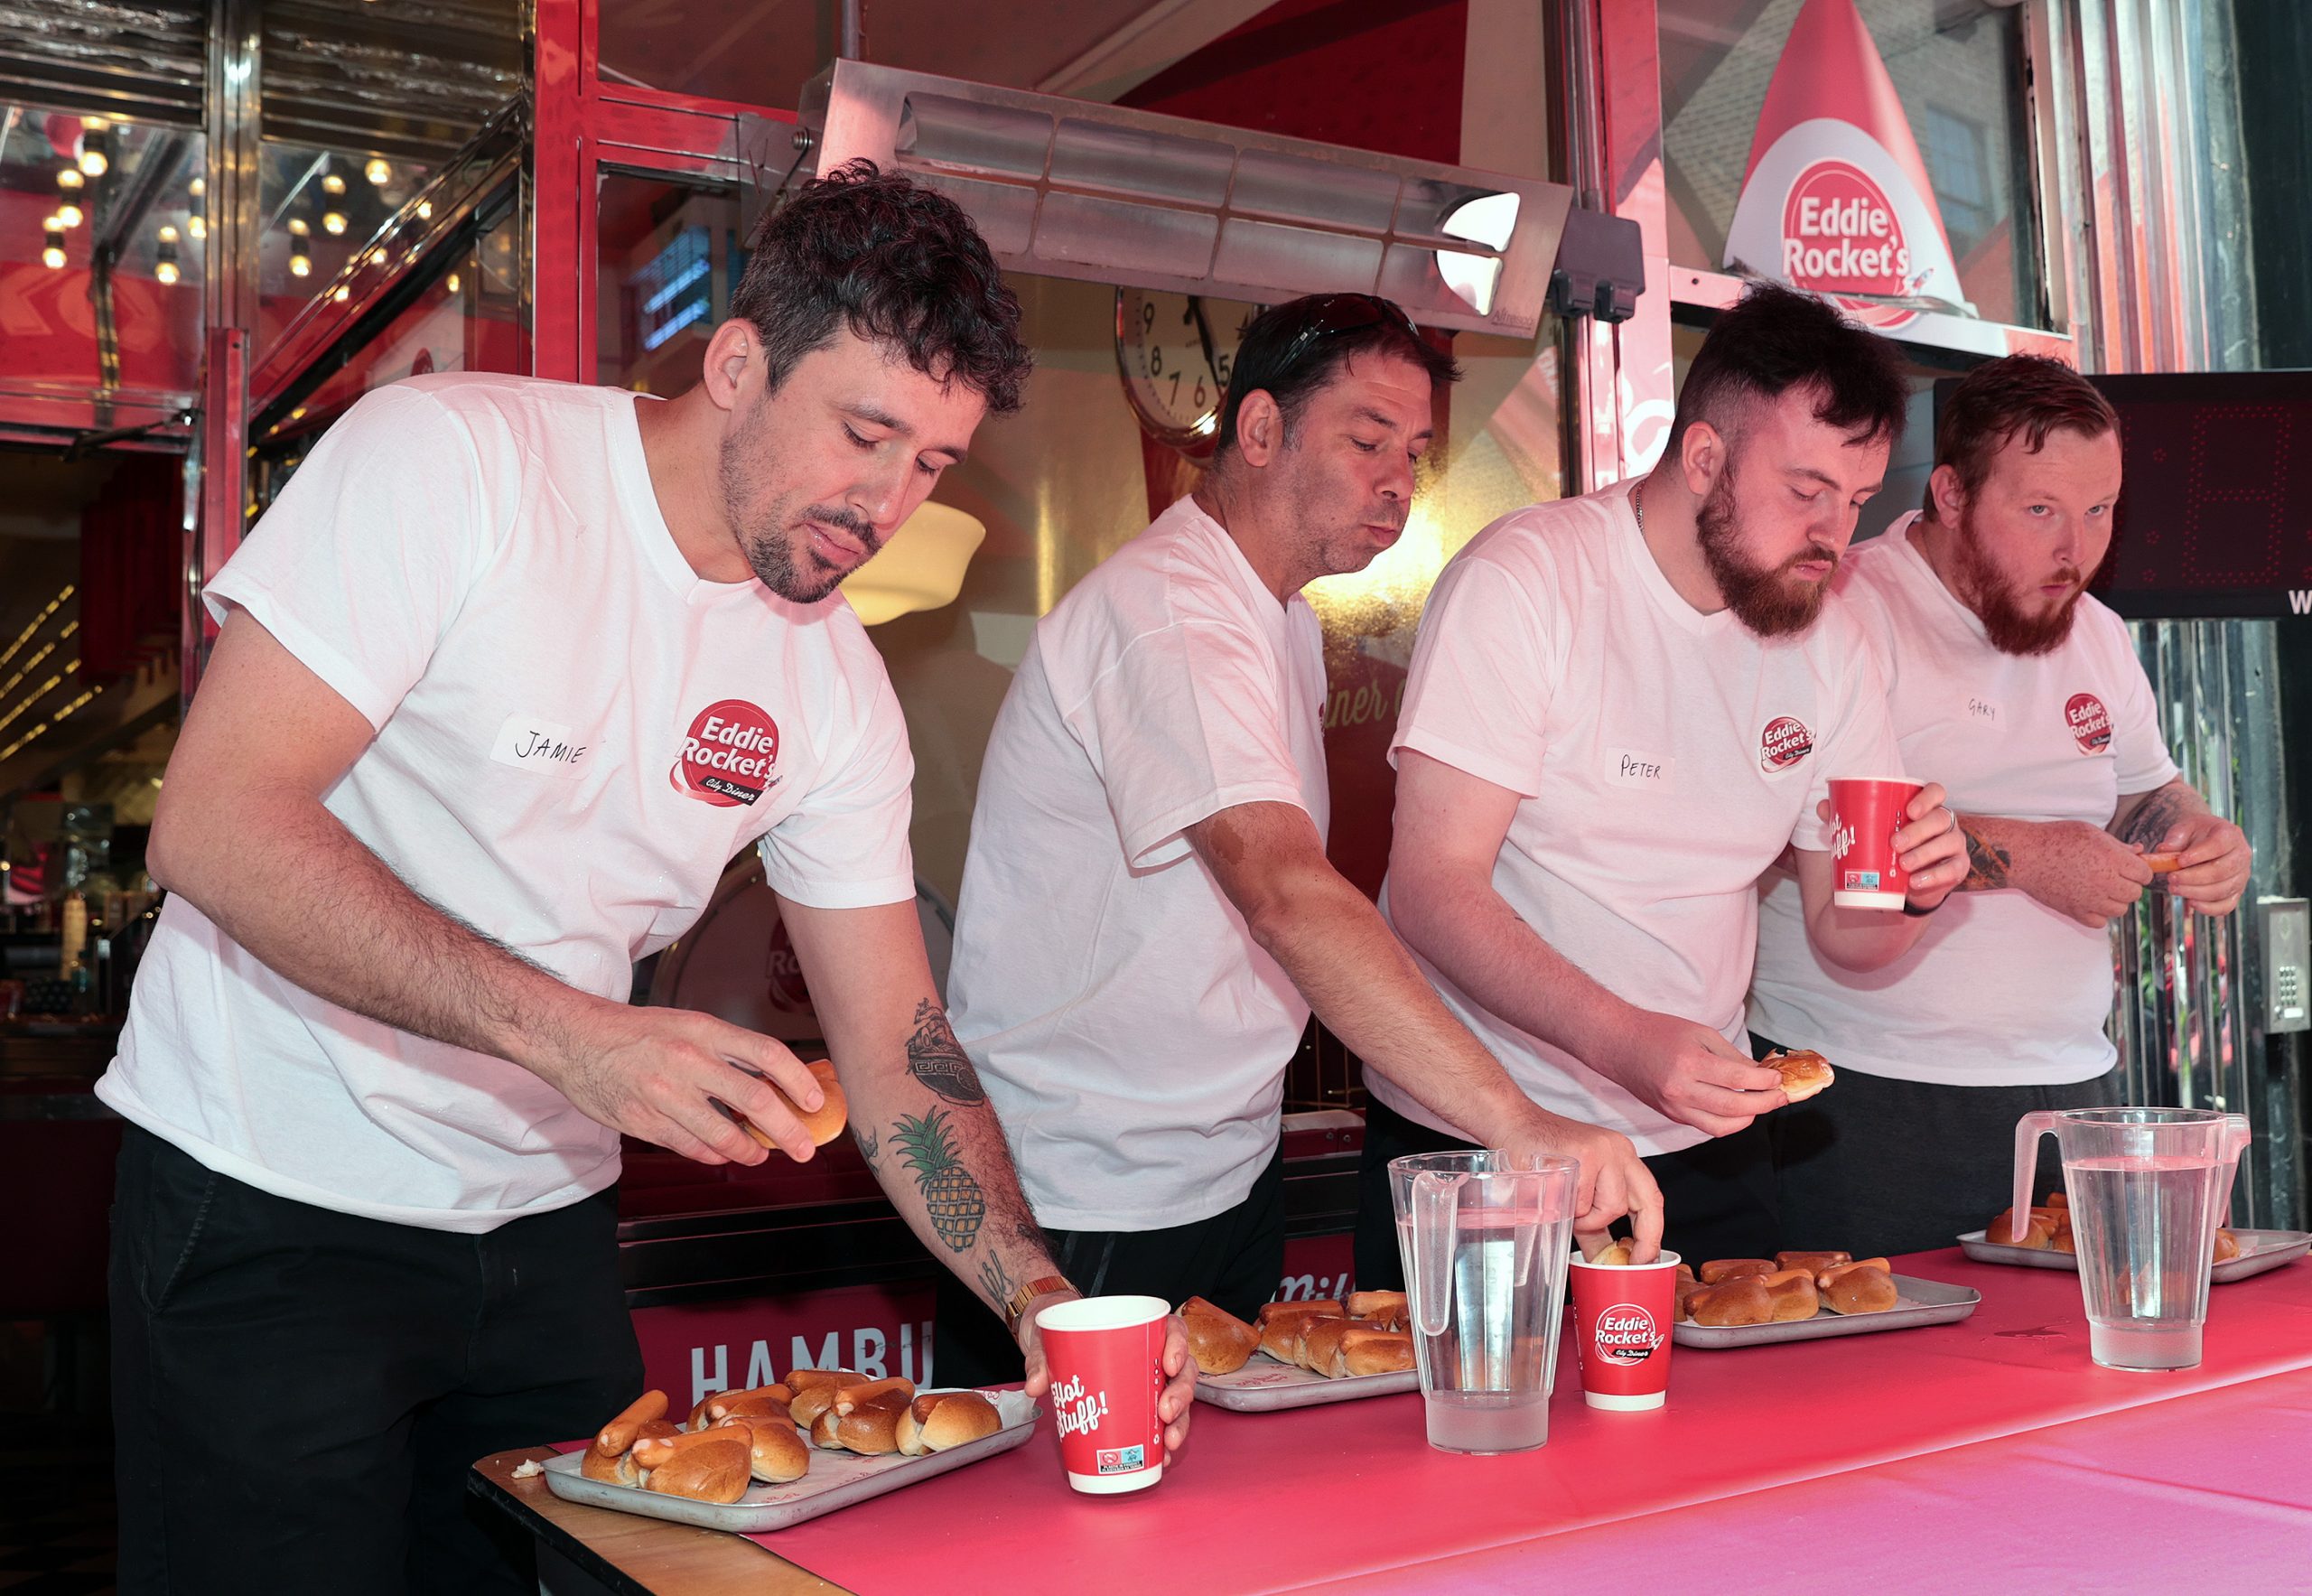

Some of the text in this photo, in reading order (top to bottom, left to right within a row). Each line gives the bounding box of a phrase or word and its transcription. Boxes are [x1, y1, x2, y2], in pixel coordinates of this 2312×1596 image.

[1800, 196, 1889, 238] Eddie
[1783, 236, 1911, 278] Rocket's
[1143, 302, 1155, 334] 9
[1151, 345, 1162, 377] 8
[1169, 370, 1181, 406] 7
[1194, 375, 1206, 408] 6
[1968, 698, 1996, 721] GARY
[2069, 701, 2102, 724] Eddie
[701, 715, 775, 754] Eddie
[1765, 722, 1801, 745] Eddie
[2069, 714, 2113, 740] Rocket's
[515, 730, 587, 764] JAMIE
[675, 736, 777, 780] Rocket's
[1761, 729, 1813, 761] Rocket's
[705, 777, 756, 802] City Diner
[1830, 812, 1842, 835] ot
[1595, 1328, 1655, 1345] Rocket's
[1604, 1316, 1649, 1331] Eddie
[1051, 1374, 1085, 1409] Hot
[1057, 1390, 1109, 1442] Stuff!
